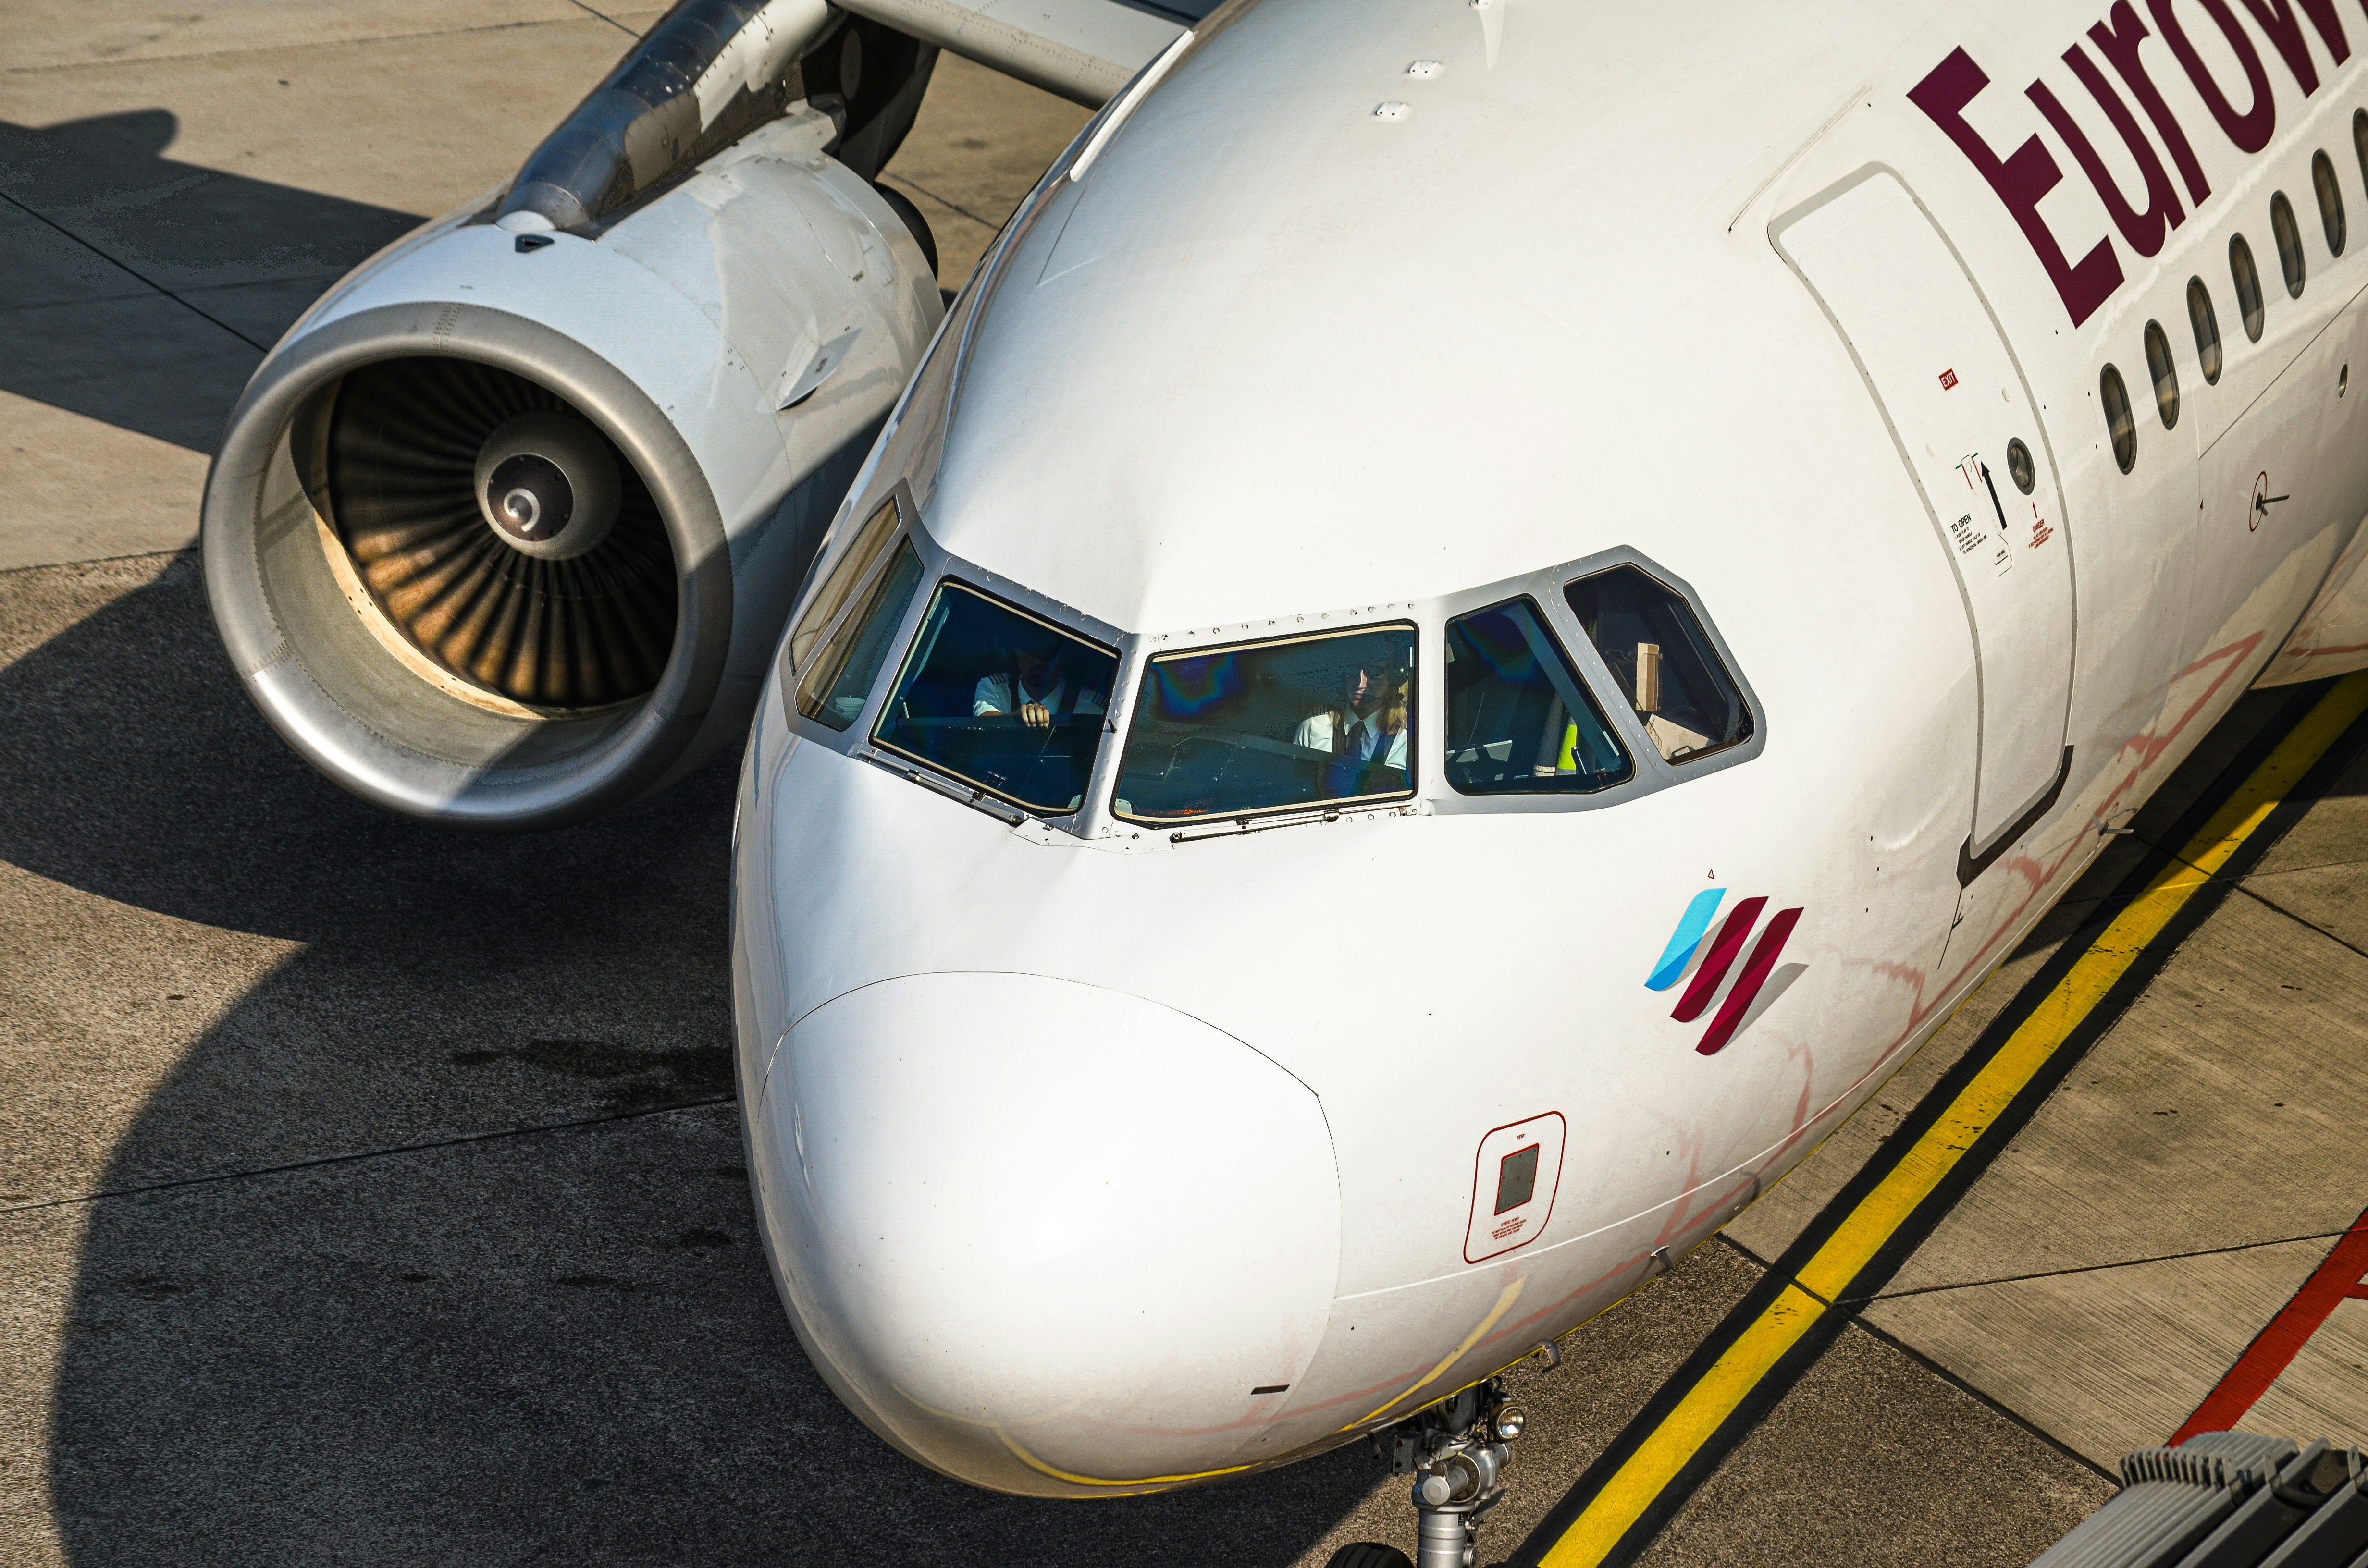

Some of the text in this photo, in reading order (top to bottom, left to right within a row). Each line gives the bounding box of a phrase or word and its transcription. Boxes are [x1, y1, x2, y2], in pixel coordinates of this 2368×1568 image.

[1941, 372, 1955, 387] EXIT
[1950, 513, 1972, 533] TO OPEN
